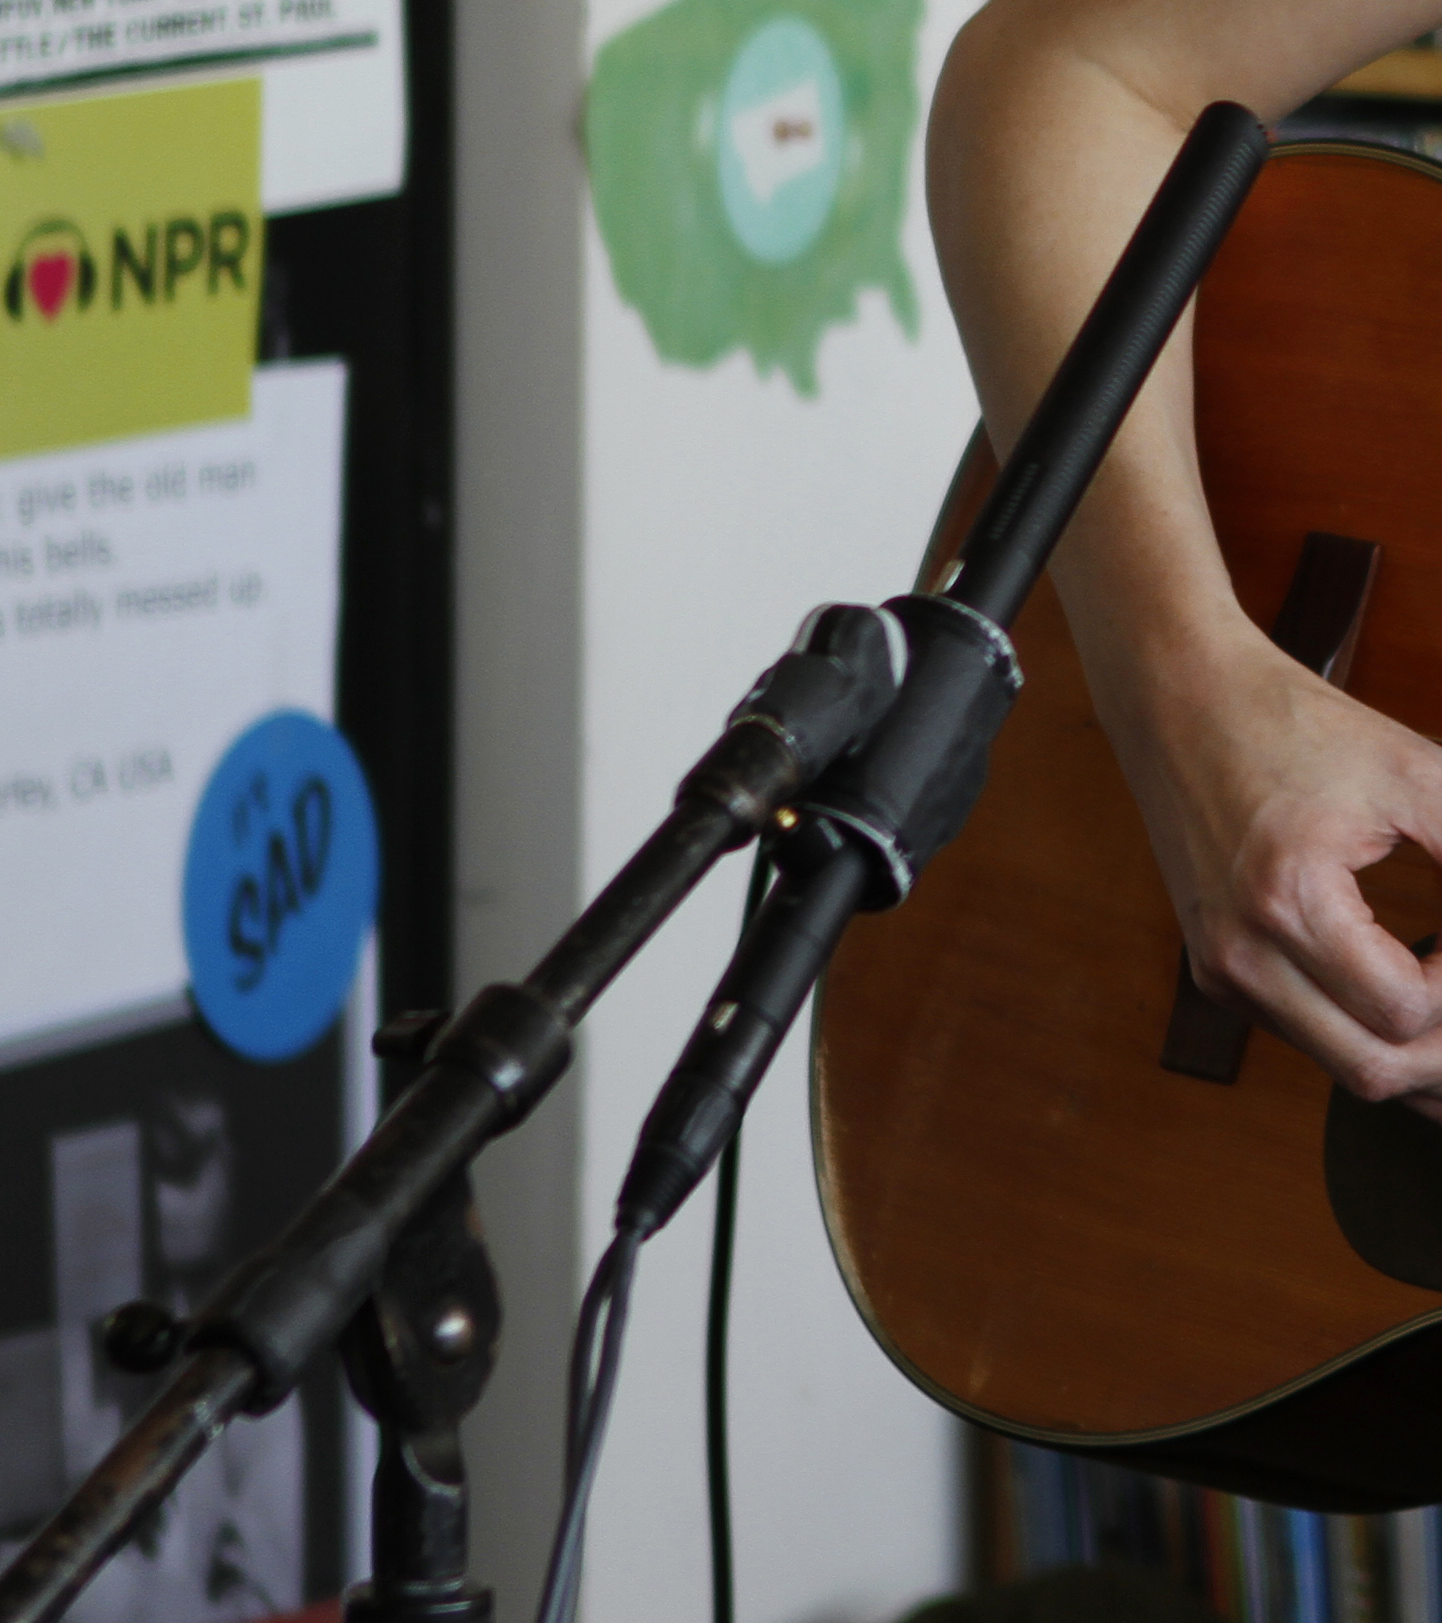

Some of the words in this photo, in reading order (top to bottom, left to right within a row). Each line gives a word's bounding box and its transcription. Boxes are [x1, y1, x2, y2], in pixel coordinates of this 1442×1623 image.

[110, 210, 251, 313] NPR
[18, 485, 76, 526] give
[88, 471, 134, 510] the
[146, 462, 187, 502] old
[200, 461, 257, 493] man
[16, 590, 102, 636] totally
[116, 572, 218, 618] messed
[228, 774, 332, 995] SAD
